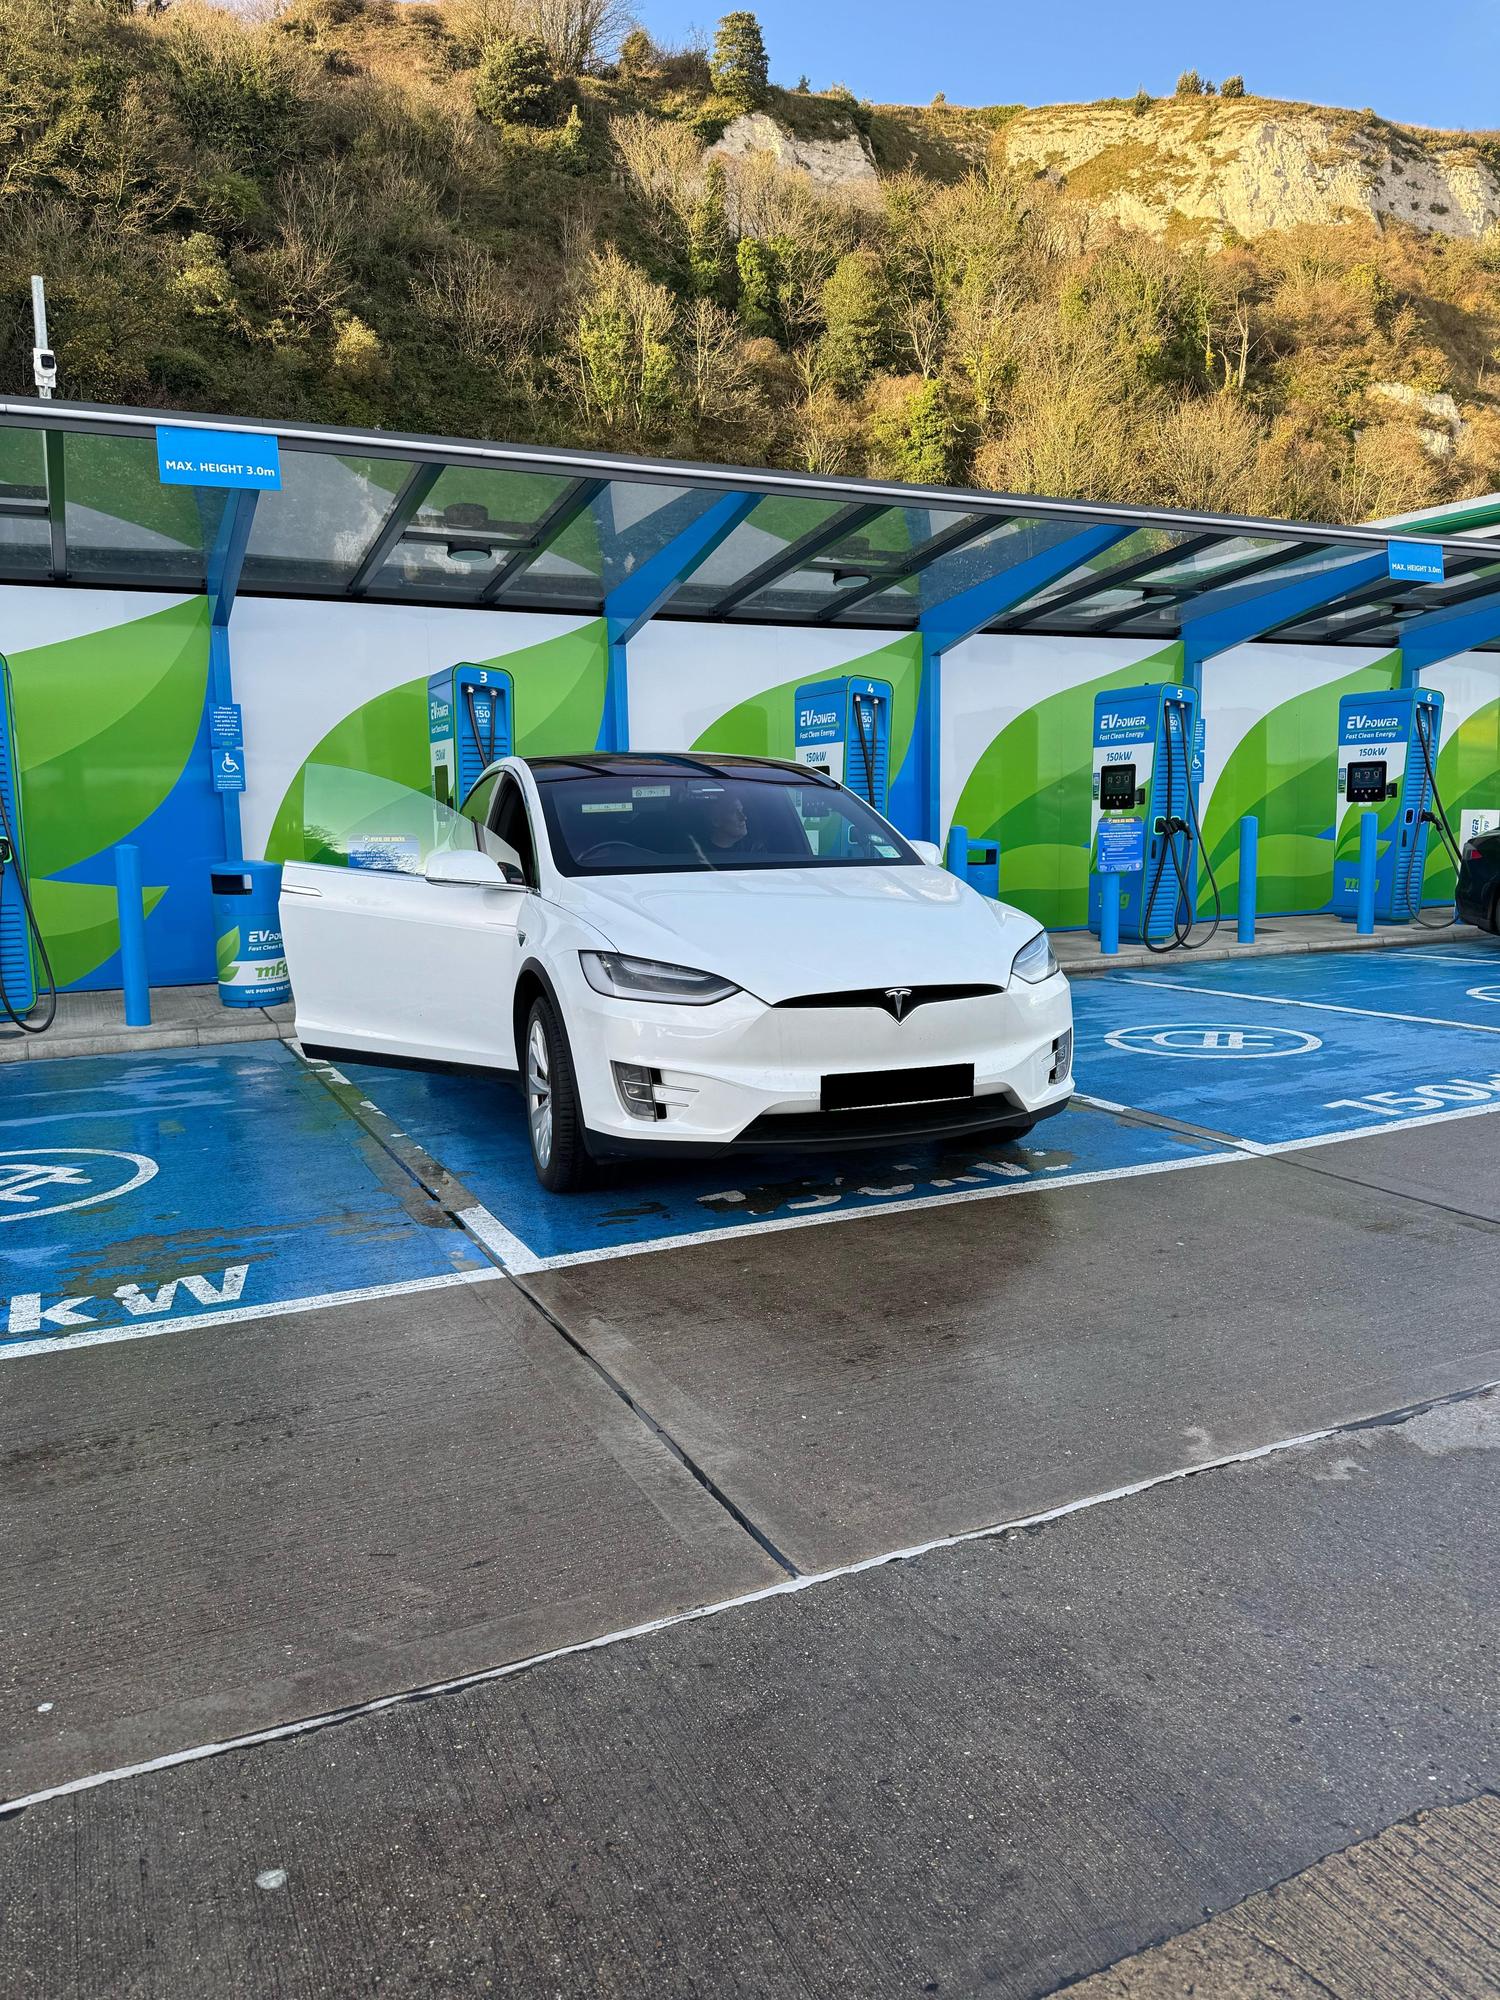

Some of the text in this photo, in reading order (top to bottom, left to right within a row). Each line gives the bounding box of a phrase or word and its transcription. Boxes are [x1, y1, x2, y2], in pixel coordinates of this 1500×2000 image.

[165, 460, 275, 477] MAX. HEIGHT 3.0m
[1391, 562, 1442, 574] MAX. HEIGHT 3.0m
[479, 671, 488, 683] 3
[867, 683, 874, 694] 4
[1176, 689, 1183, 699] 5
[1427, 693, 1432, 702] 6
[475, 710, 491, 718] 150
[820, 729, 836, 737] Energy
[1099, 731, 1145, 741] Fast Clean Energy
[806, 751, 827, 763] 150kW
[1106, 751, 1133, 762] 150kW
[1359, 747, 1388, 757] 150kW
